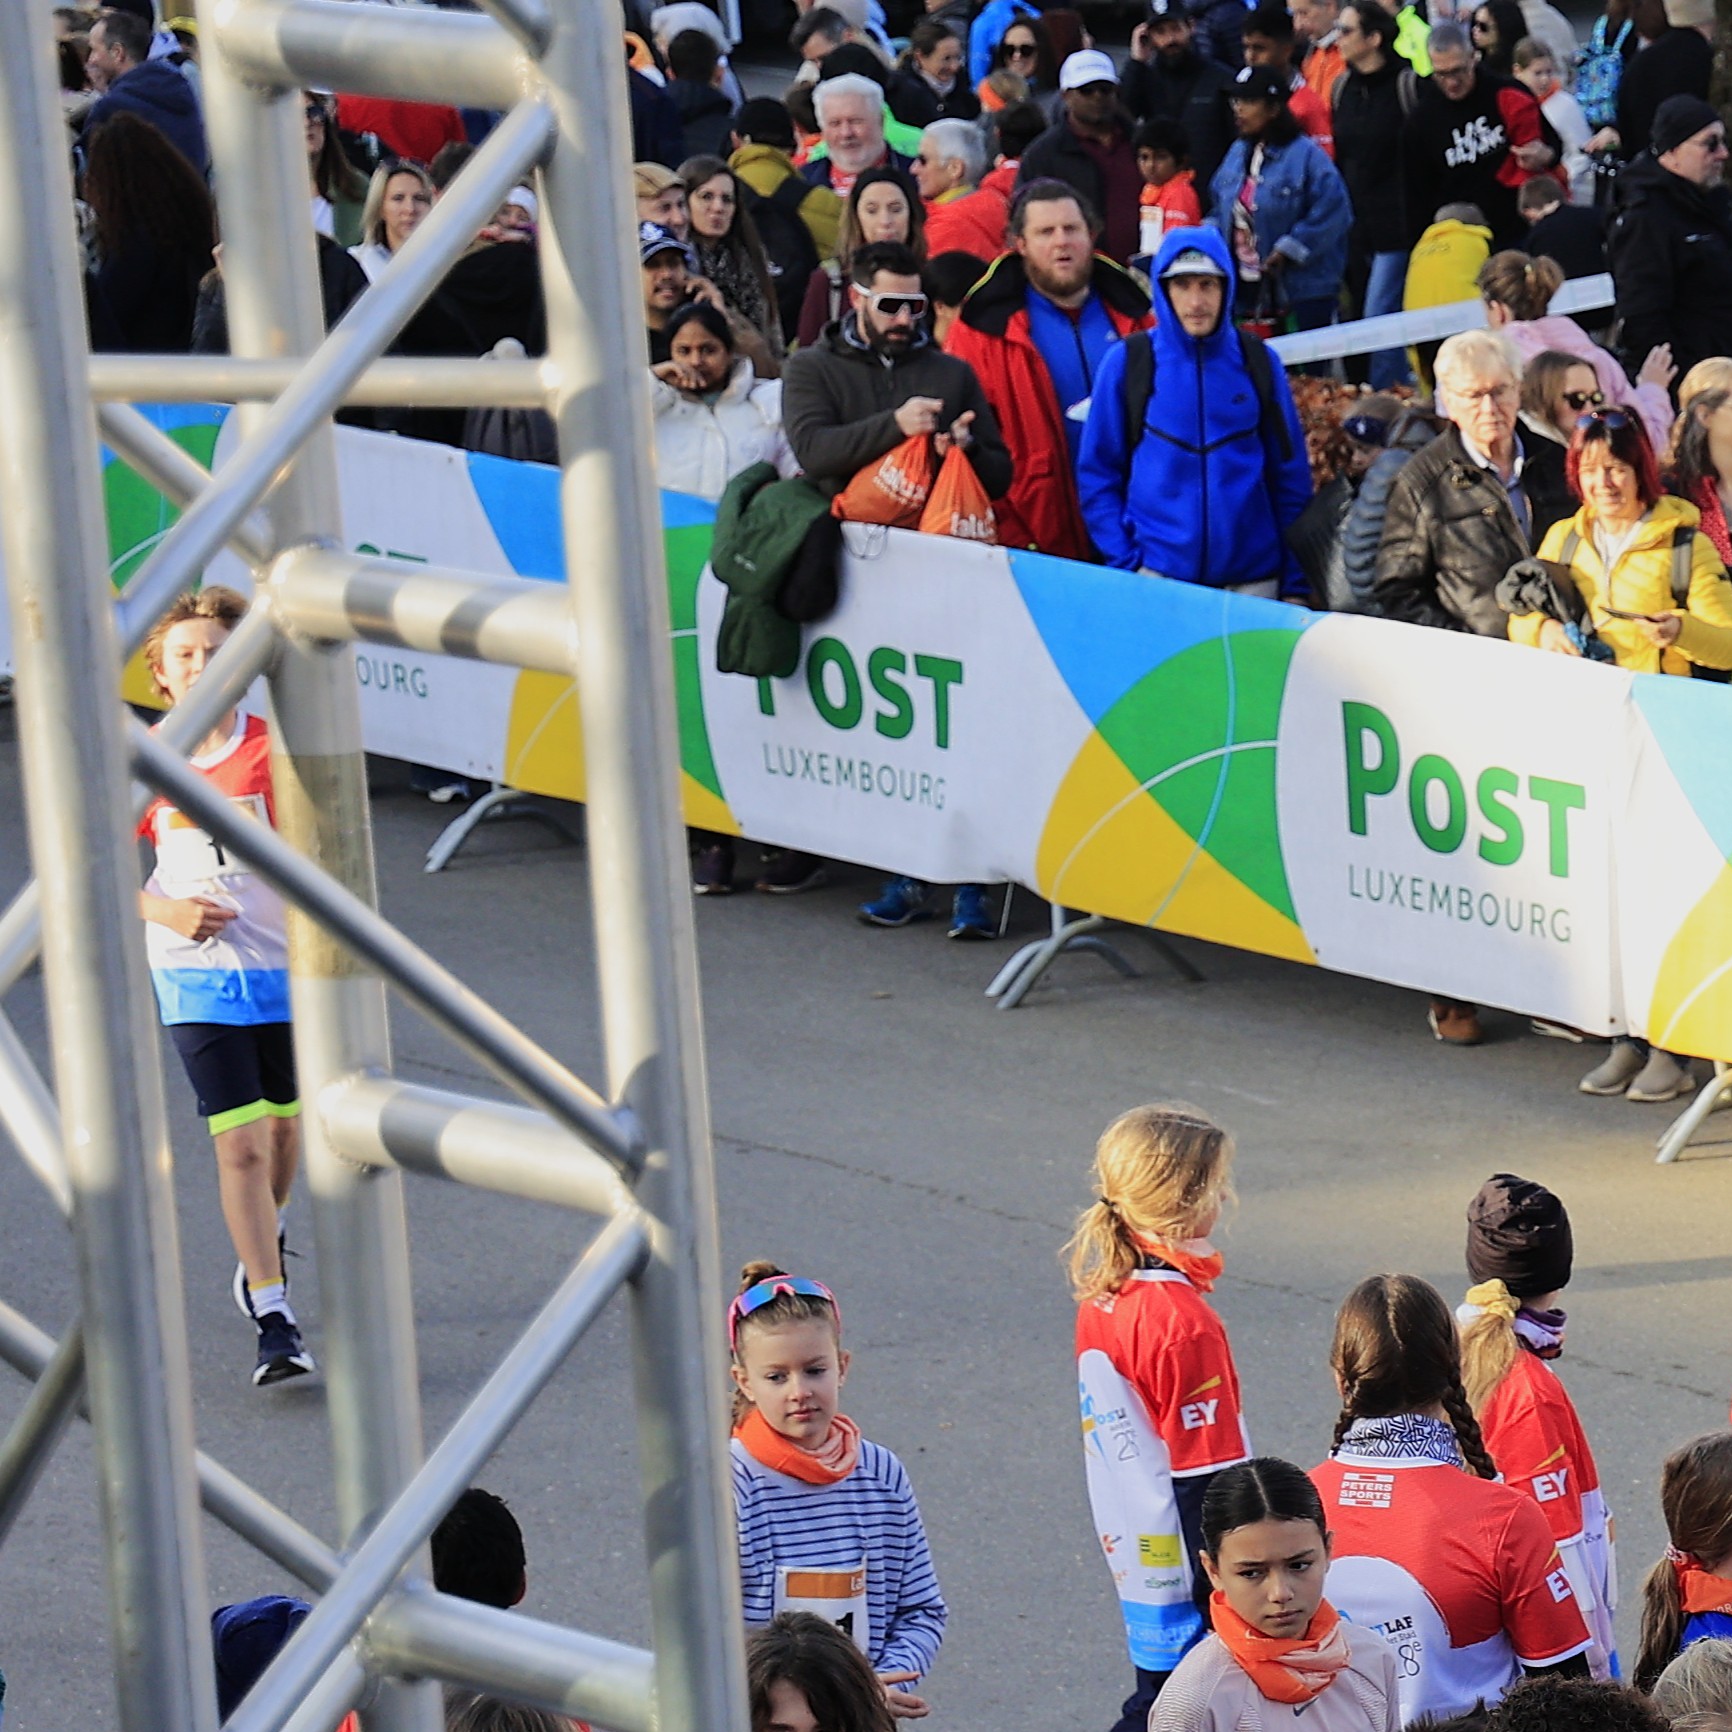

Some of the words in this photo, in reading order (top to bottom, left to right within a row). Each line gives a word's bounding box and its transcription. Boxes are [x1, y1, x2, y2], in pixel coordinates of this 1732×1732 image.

[757, 635, 963, 750] OST
[762, 742, 946, 811] LUXEMBOURG
[1341, 700, 1587, 879] POST
[1347, 863, 1573, 943] LUXEMBOURG
[1179, 1399, 1219, 1430] EY
[1340, 1490, 1391, 1501] SPORTS
[1341, 1480, 1393, 1492] PETERS
[1530, 1468, 1569, 1504] EY
[1545, 1566, 1574, 1605] E
[1386, 1614, 1414, 1635] LAF
